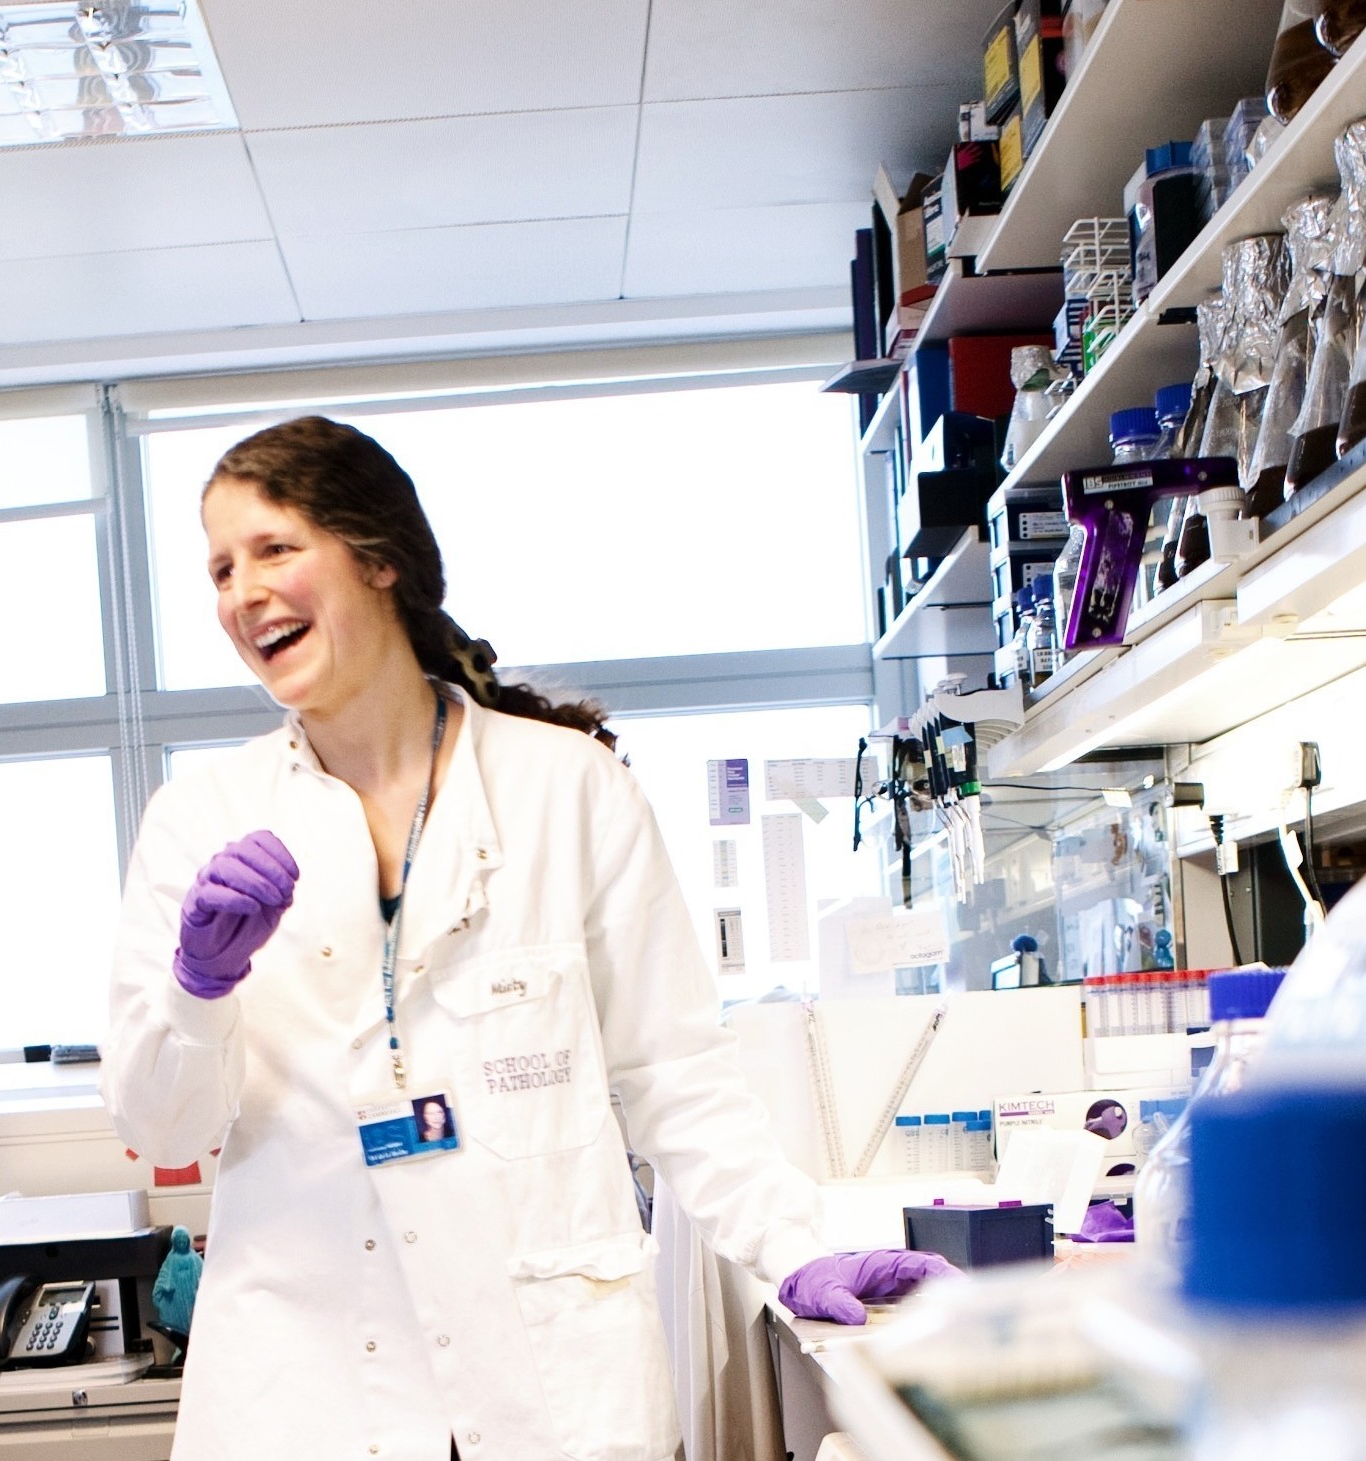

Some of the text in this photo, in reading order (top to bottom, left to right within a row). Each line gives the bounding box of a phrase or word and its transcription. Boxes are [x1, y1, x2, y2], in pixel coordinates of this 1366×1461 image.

[482, 1049, 571, 1077] SCHOOL OF
[486, 1066, 572, 1095] PATHOLOGY
[998, 1100, 1056, 1112] KIMTECH
[999, 1118, 1043, 1127] PURPLE NITRILE
